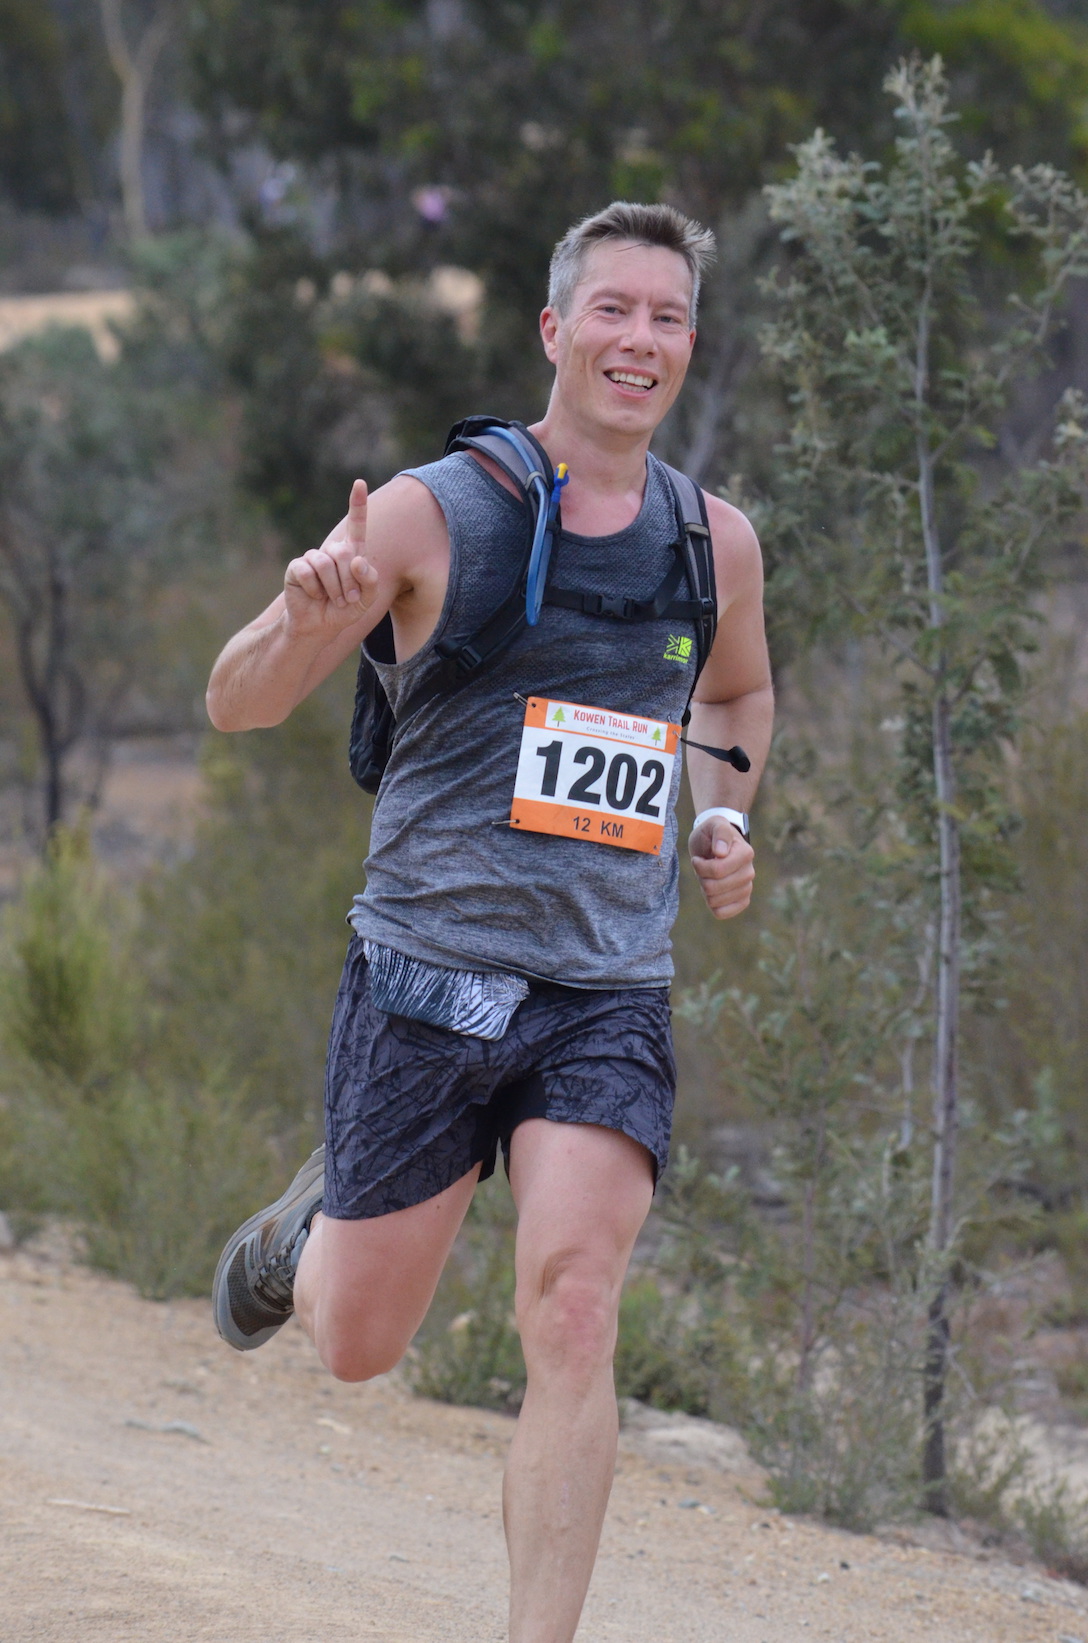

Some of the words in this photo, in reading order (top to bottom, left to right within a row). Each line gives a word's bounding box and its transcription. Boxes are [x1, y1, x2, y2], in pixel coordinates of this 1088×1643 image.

[573, 709, 606, 725] KOWEN
[608, 715, 630, 730] TRAIL
[632, 720, 648, 734] RUN
[536, 740, 665, 818] 1202
[573, 816, 590, 832] 12
[601, 821, 624, 838] KM
